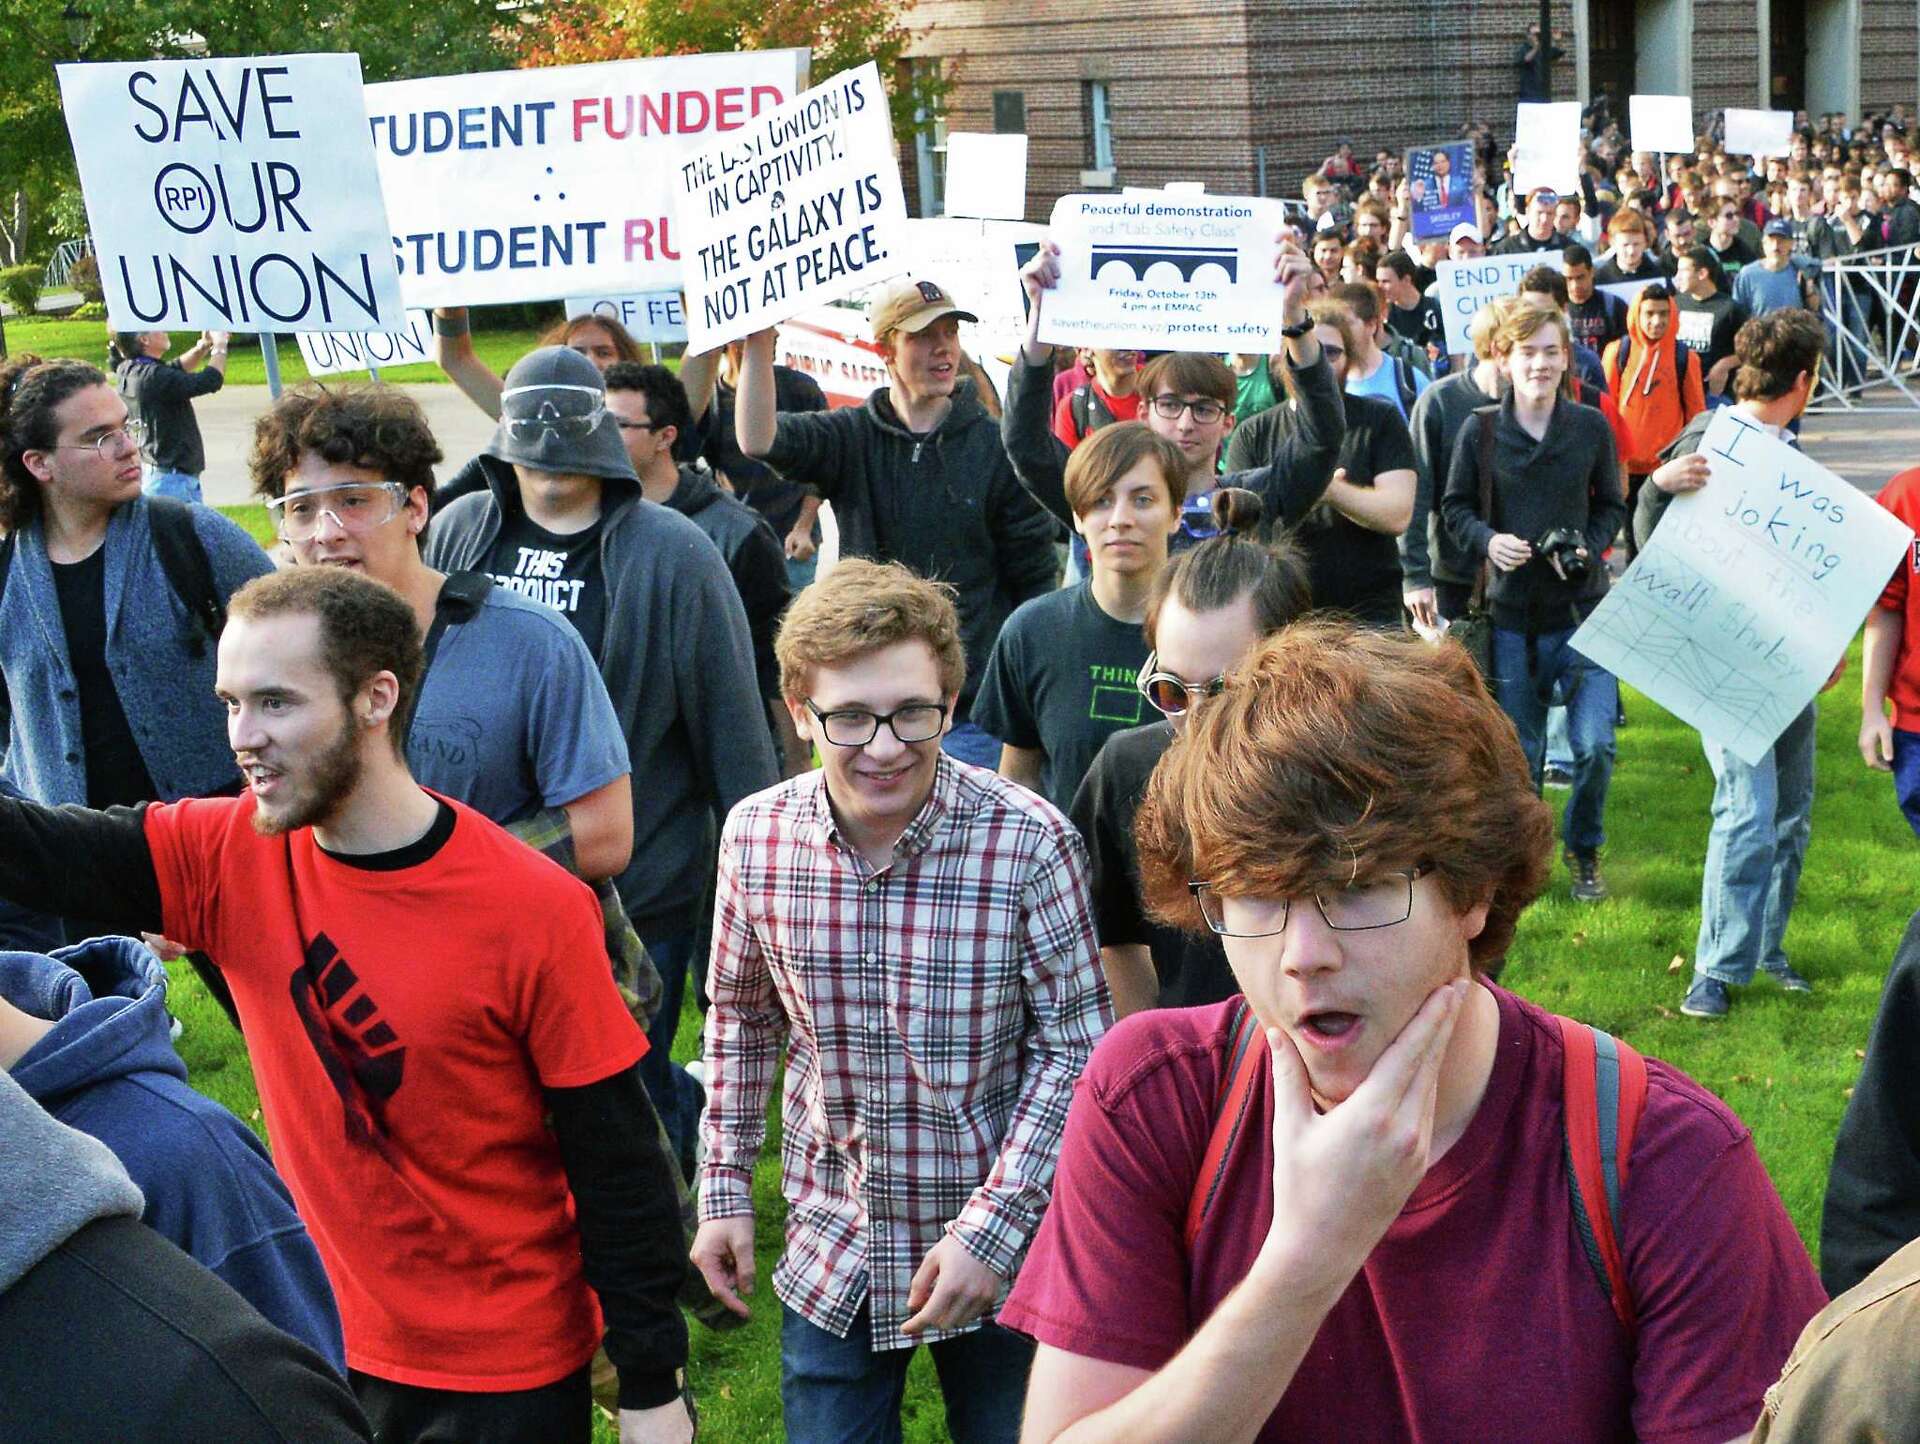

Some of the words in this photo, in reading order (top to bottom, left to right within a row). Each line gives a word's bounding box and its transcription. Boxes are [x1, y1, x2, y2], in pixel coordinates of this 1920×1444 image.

[127, 66, 301, 143] SAVE
[369, 101, 556, 156] UDENT
[682, 155, 716, 192] THE
[768, 90, 840, 148] UNION
[844, 79, 865, 114] IS
[708, 183, 729, 218] IN
[735, 130, 844, 204] CAPTIVITY.
[154, 162, 312, 235] OUR
[164, 186, 206, 212] RPI
[1081, 202, 1140, 216] Peaceful
[1145, 203, 1253, 218] demonstration
[624, 216, 682, 262] RU
[698, 234, 740, 282] THE
[747, 188, 845, 262] GALAXY
[855, 174, 882, 215] IS
[1089, 222, 1115, 235] and
[1155, 223, 1197, 239] Safety
[119, 253, 380, 325] UNION
[704, 277, 751, 329] NOT
[762, 261, 788, 307] AT
[796, 225, 888, 292] PEACE.
[1108, 288, 1144, 300] Friday,
[1147, 288, 1190, 300] October
[1194, 290, 1217, 300] 13th
[1454, 266, 1500, 288] END
[1121, 301, 1128, 311] 4
[1131, 304, 1147, 313] pm
[1151, 303, 1161, 312] at
[1165, 303, 1203, 313] EMPAC
[306, 321, 426, 369] UNION
[841, 362, 887, 382] SAFET
[1712, 416, 1760, 467] I
[1778, 471, 1846, 525] was
[514, 546, 568, 579] THIS
[484, 573, 585, 612] ODUCT
[1088, 665, 1138, 685] THIN
